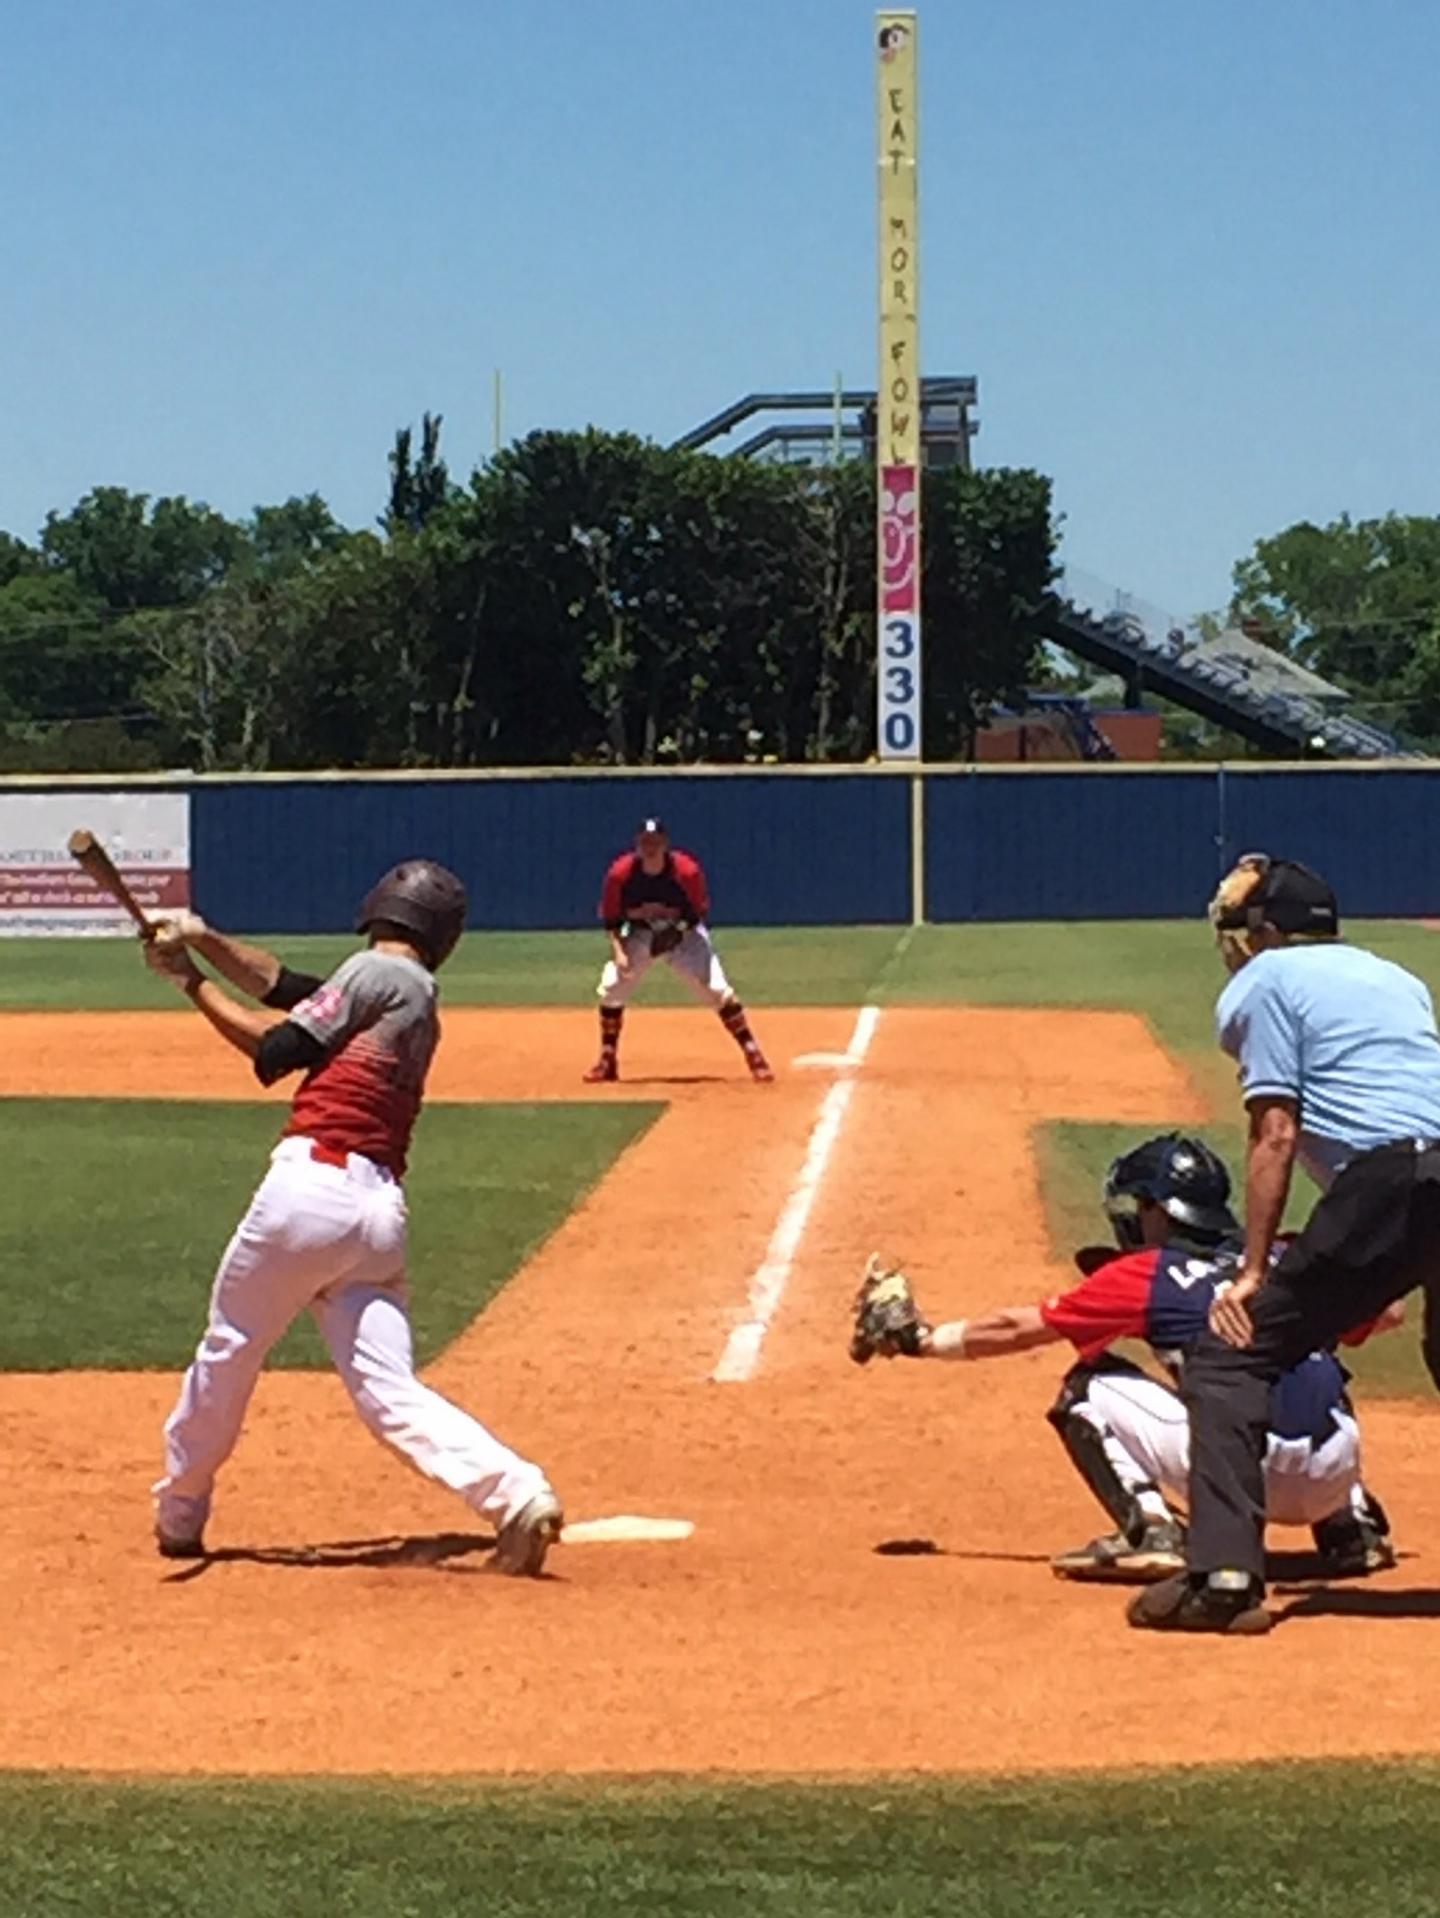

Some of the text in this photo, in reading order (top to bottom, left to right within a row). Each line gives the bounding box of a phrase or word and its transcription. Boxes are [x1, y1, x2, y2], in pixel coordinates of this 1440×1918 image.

[888, 88, 909, 464] EAT MOR FOWL
[885, 621, 915, 750] 330
